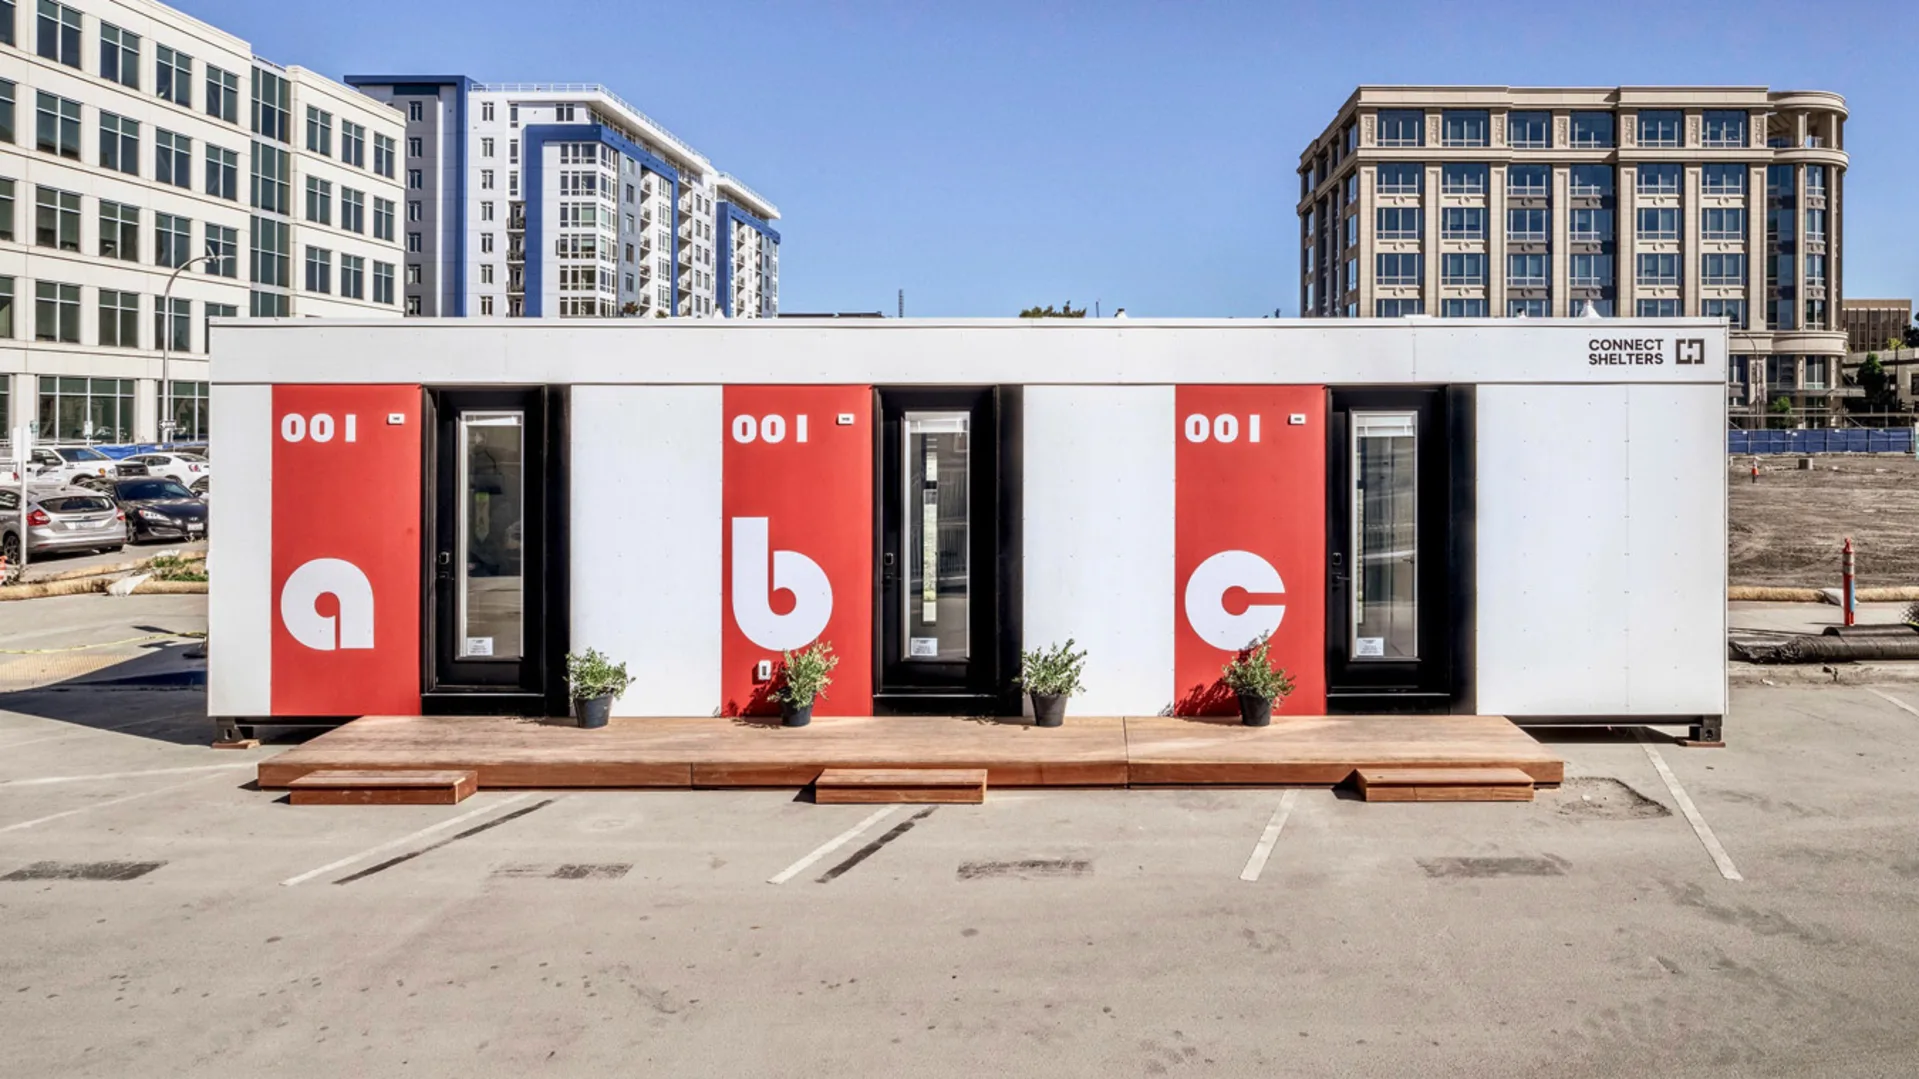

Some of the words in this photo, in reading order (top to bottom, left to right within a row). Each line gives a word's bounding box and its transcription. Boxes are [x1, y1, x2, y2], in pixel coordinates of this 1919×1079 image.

[1588, 339, 1664, 351] CONNECT
[1588, 353, 1664, 366] SHELTERS
[281, 412, 357, 443] 001
[732, 413, 808, 444] 001
[1184, 413, 1261, 444] 001
[732, 516, 834, 652] b
[280, 557, 375, 651] a
[1184, 549, 1287, 652] c
